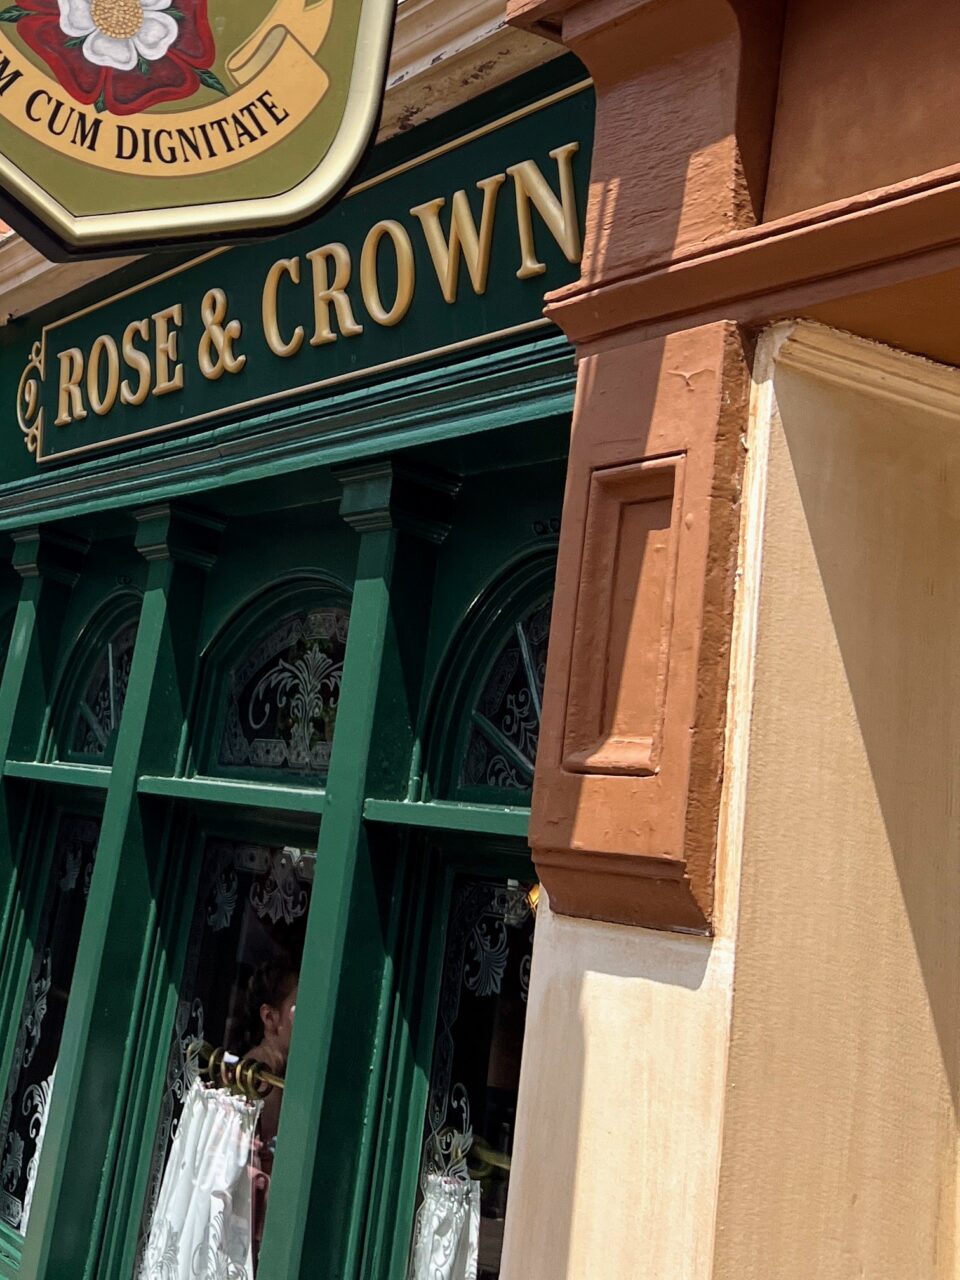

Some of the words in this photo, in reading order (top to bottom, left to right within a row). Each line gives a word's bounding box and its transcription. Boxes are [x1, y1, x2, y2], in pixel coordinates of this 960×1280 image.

[25, 89, 102, 151] CUM
[115, 90, 290, 163] DIGNITATE
[54, 303, 184, 427] ROSE
[197, 287, 247, 381] &
[262, 142, 583, 358] CROWN
